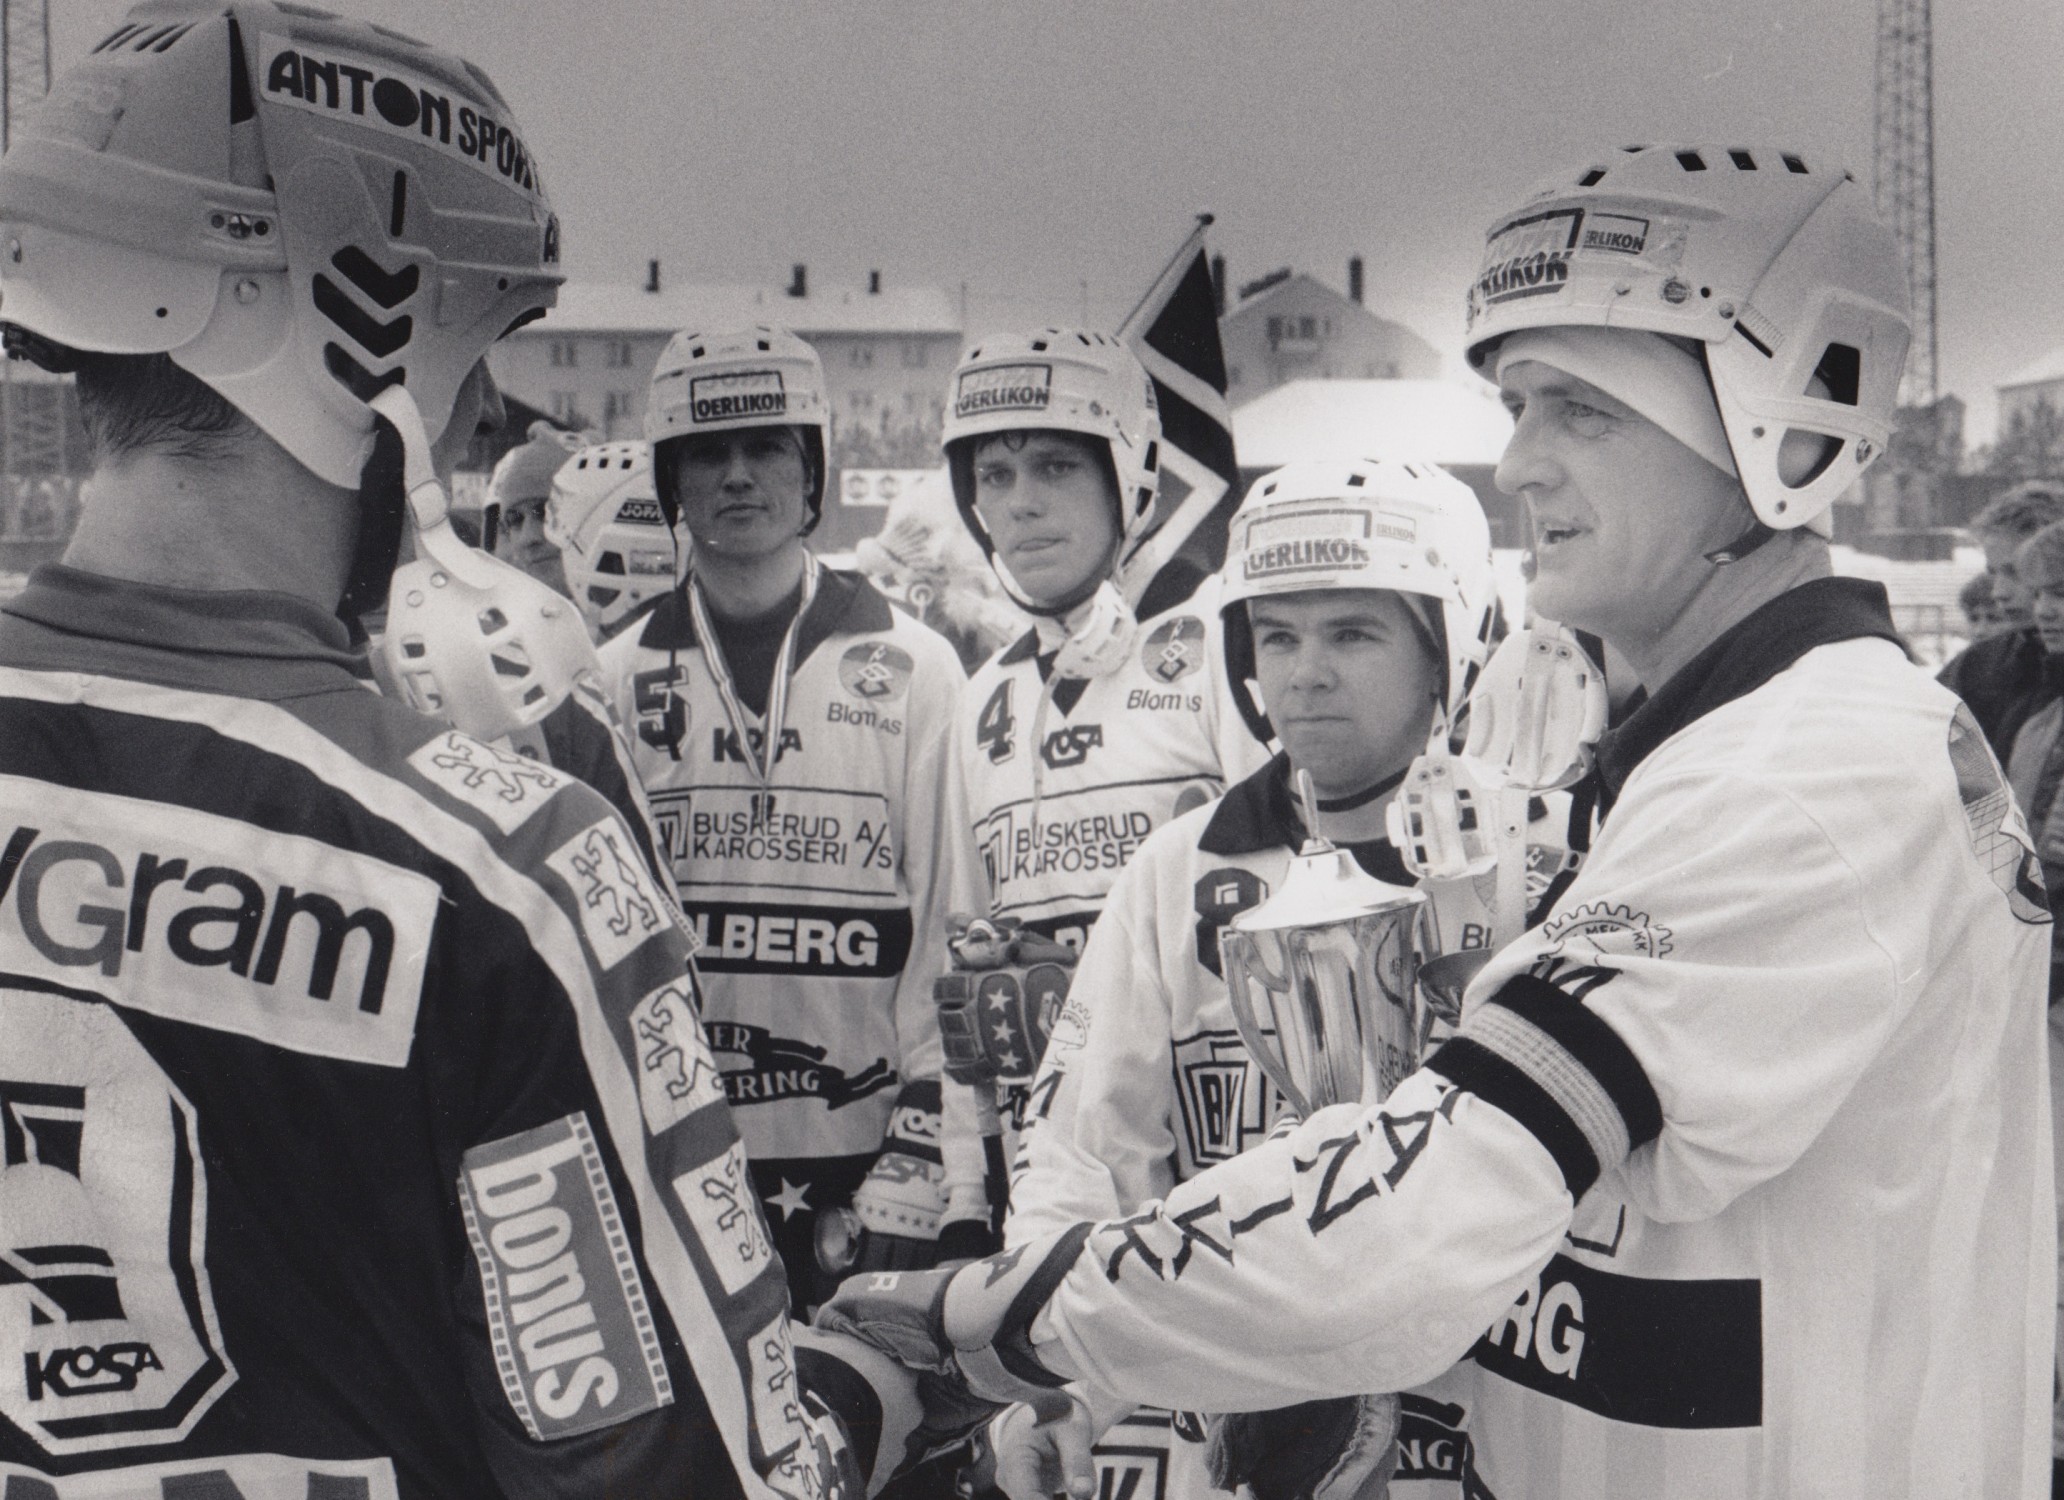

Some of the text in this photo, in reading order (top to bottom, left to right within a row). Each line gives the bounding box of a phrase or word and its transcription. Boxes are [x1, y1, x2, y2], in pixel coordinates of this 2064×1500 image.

[267, 50, 542, 198] ANTON SPOR
[696, 393, 787, 417] OERLIKON
[959, 386, 1049, 411] OERLIKON
[1126, 689, 1182, 711] Blom
[976, 677, 1016, 766] 4
[694, 812, 841, 840] BUSKERUD
[854, 820, 893, 869] A/S
[1016, 811, 1152, 855] BUSKERUD
[693, 836, 848, 866] KAROSSERI
[712, 1024, 752, 1052] ER
[470, 1137, 619, 1419] bonus
[24, 1341, 164, 1401] KOSA
